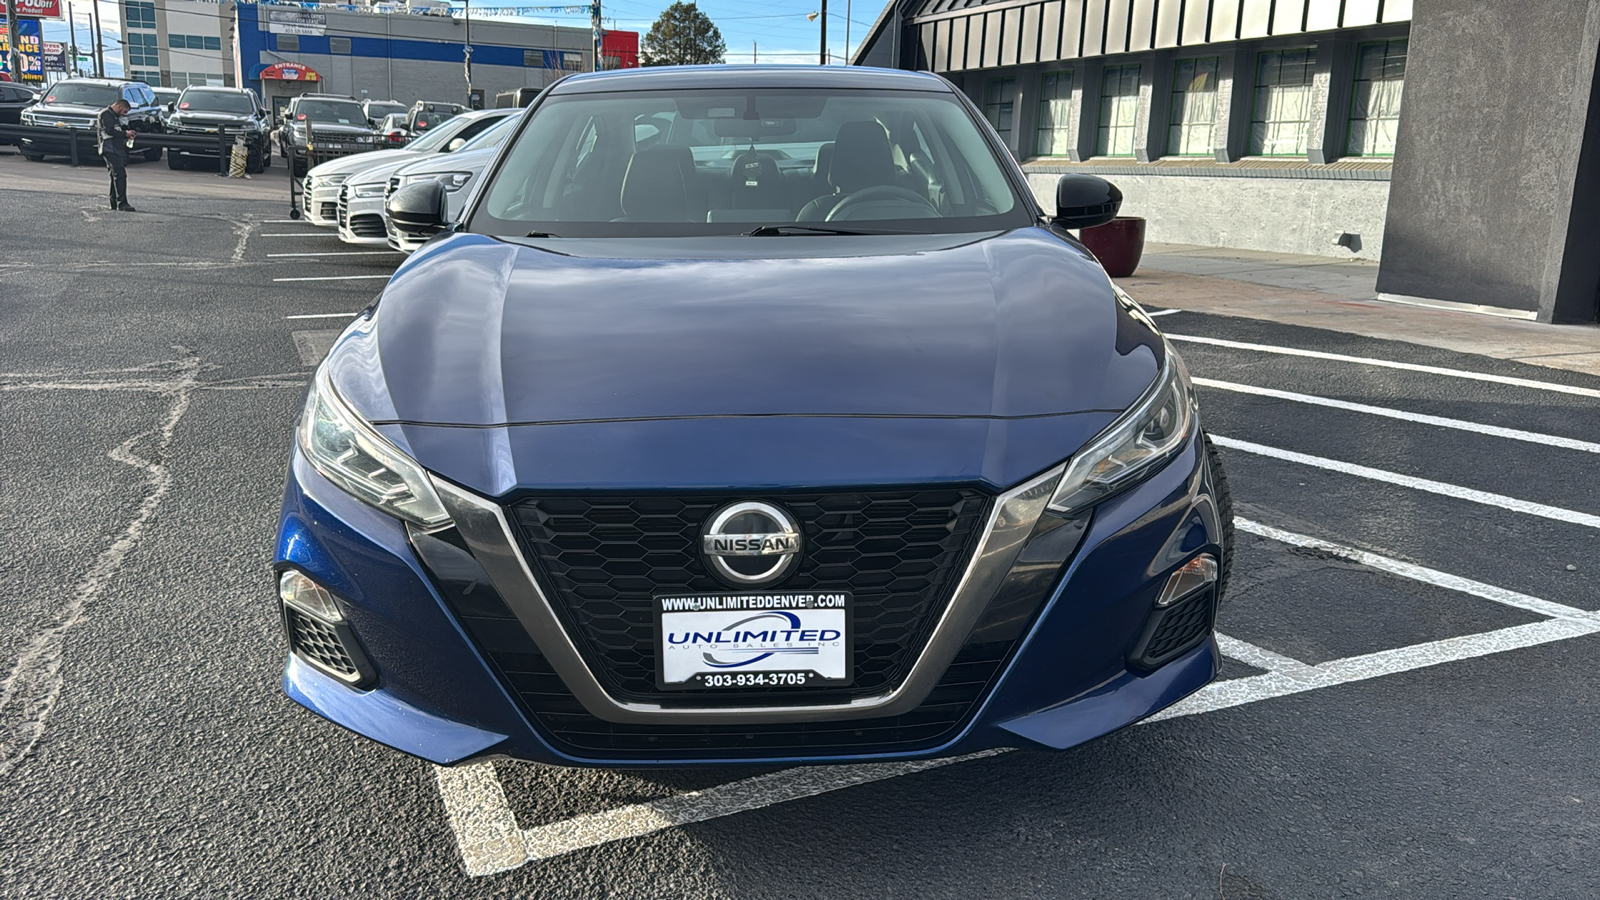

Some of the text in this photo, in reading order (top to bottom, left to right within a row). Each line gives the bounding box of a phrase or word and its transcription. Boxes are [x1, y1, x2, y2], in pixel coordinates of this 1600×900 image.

[274, 62, 306, 70] ENTRANCE
[714, 538, 790, 551] NISSAN
[662, 594, 845, 611] WWWUNLIMITEDDENVER.COM
[668, 629, 841, 644] UNLIMITED
[704, 673, 806, 686] 303-934-3705
